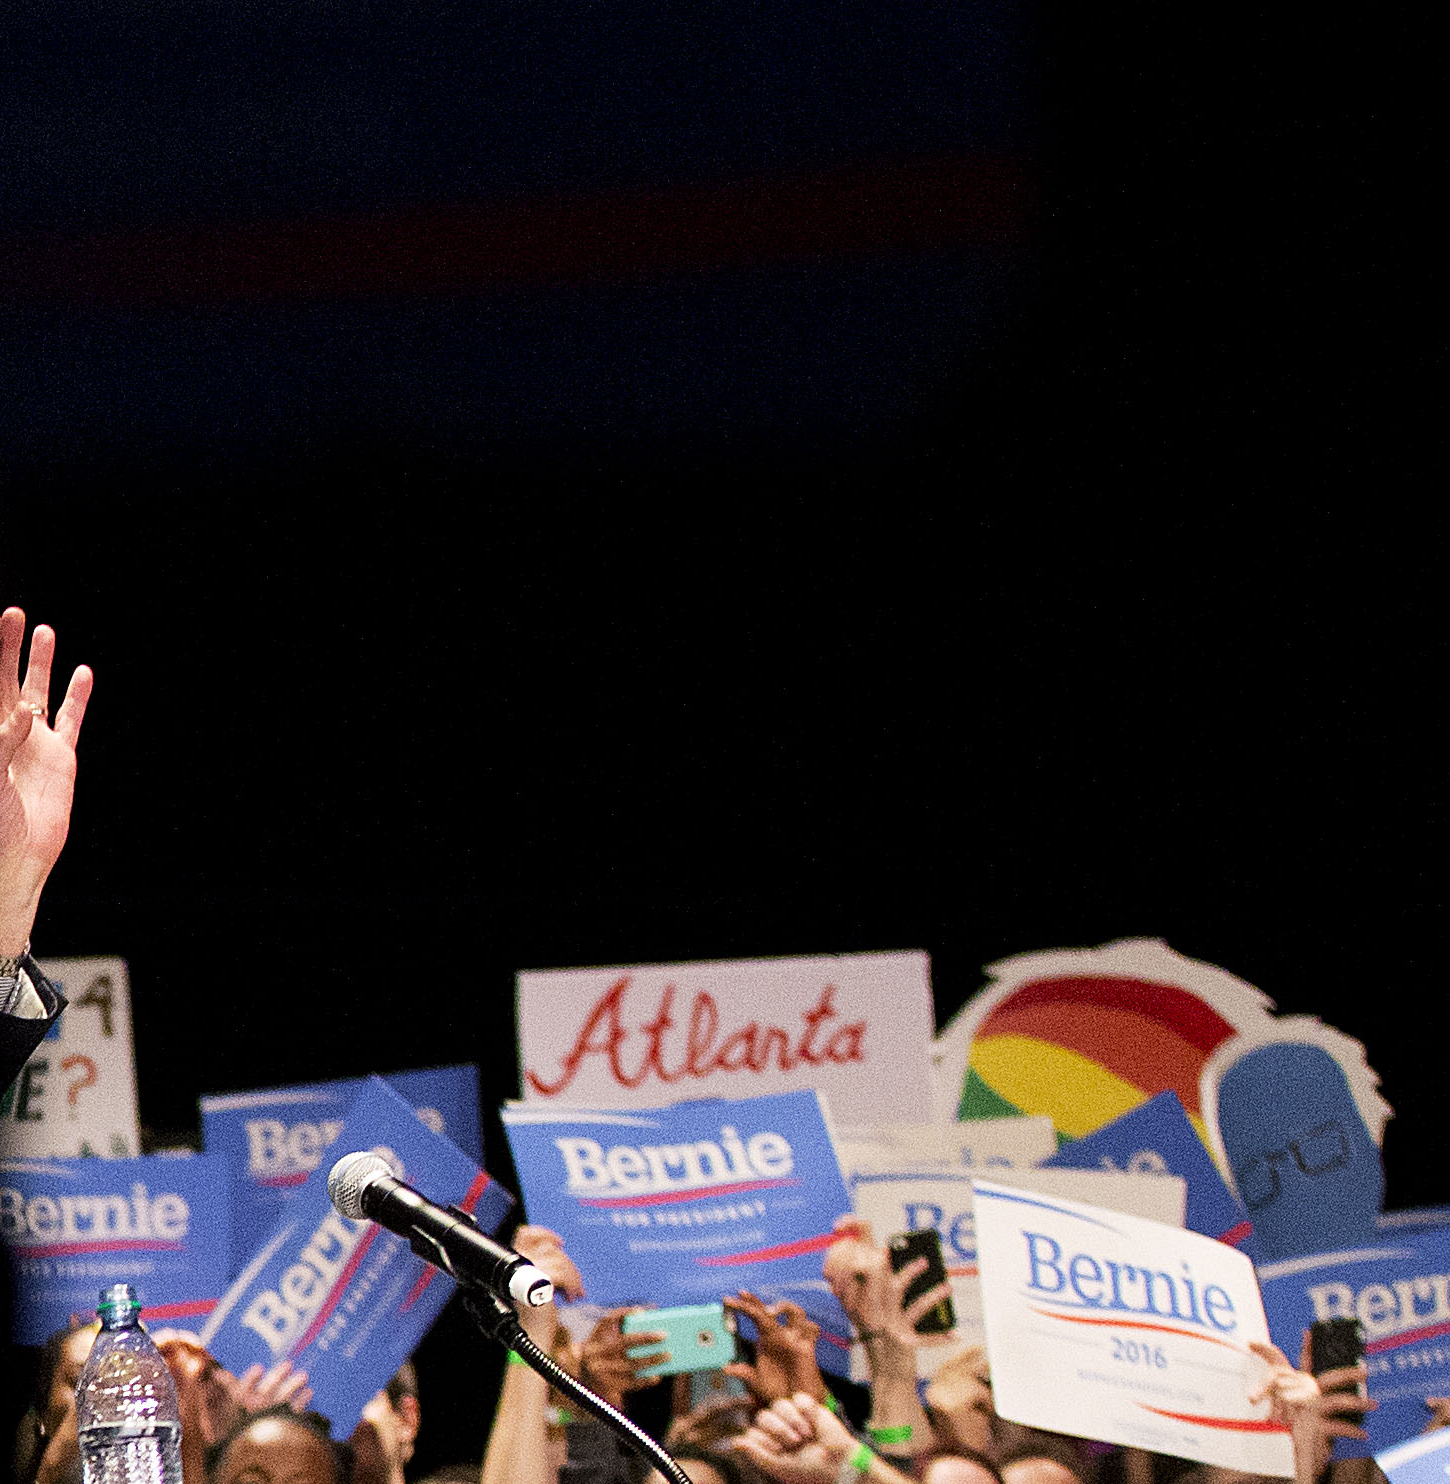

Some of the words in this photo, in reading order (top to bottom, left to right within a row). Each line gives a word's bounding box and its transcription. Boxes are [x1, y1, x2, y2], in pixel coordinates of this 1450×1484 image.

[524, 972, 868, 1096] Atlanta
[555, 1124, 796, 1197] Bernie
[1021, 1229, 1239, 1333] Bernie
[1109, 1334, 1169, 1370] 2016
